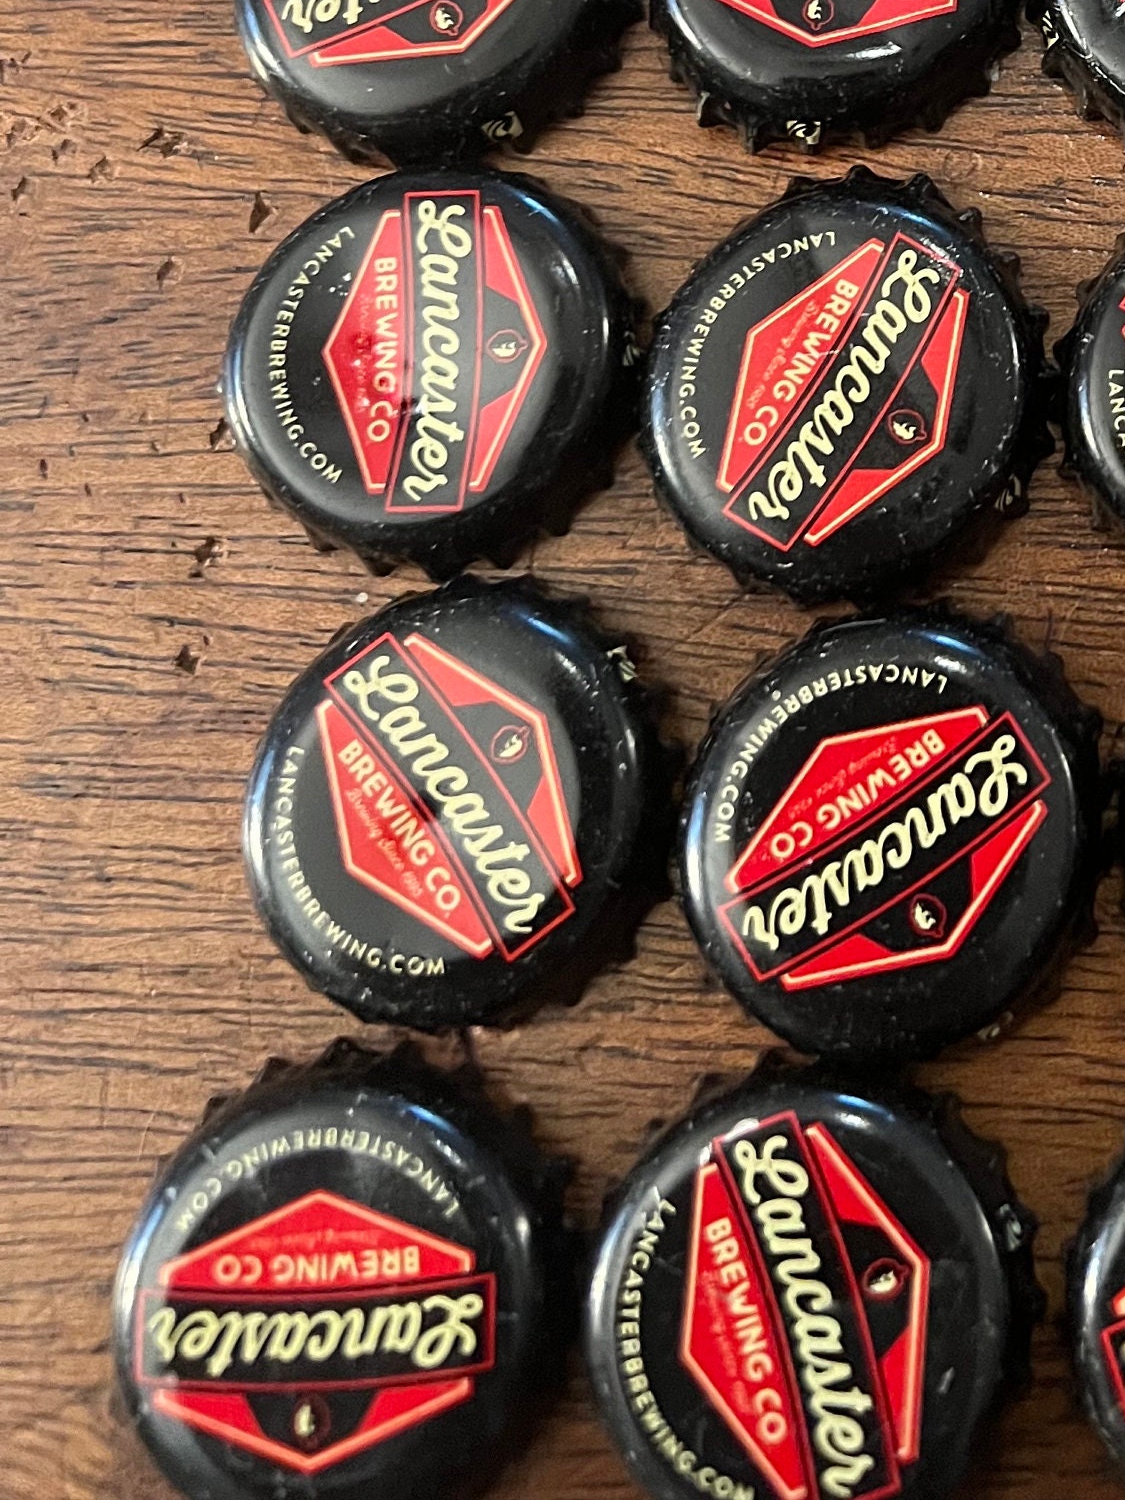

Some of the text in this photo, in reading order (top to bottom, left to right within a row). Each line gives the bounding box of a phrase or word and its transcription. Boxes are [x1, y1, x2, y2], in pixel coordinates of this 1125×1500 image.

[270, 226, 354, 482] LANCASTERBREWING.COM
[371, 257, 398, 390] BREWING
[404, 200, 472, 500] Lancaster
[679, 232, 835, 458] LANCASTERBREWING.COM
[749, 251, 939, 519] Lancaster
[773, 278, 858, 400] BREWING
[338, 740, 431, 866] BREWING
[343, 657, 543, 933] Lancaster
[714, 666, 947, 841] LANCASTERBREWING.COM
[742, 734, 1028, 950] Lancaster
[817, 729, 945, 829] BREWING
[275, 743, 445, 975] LANCASTERBREWING.COM
[144, 1294, 480, 1377] Lancaster
[272, 1245, 419, 1280] BREWING
[708, 1219, 771, 1380] BREWING
[735, 1138, 872, 1496] Lancaster
